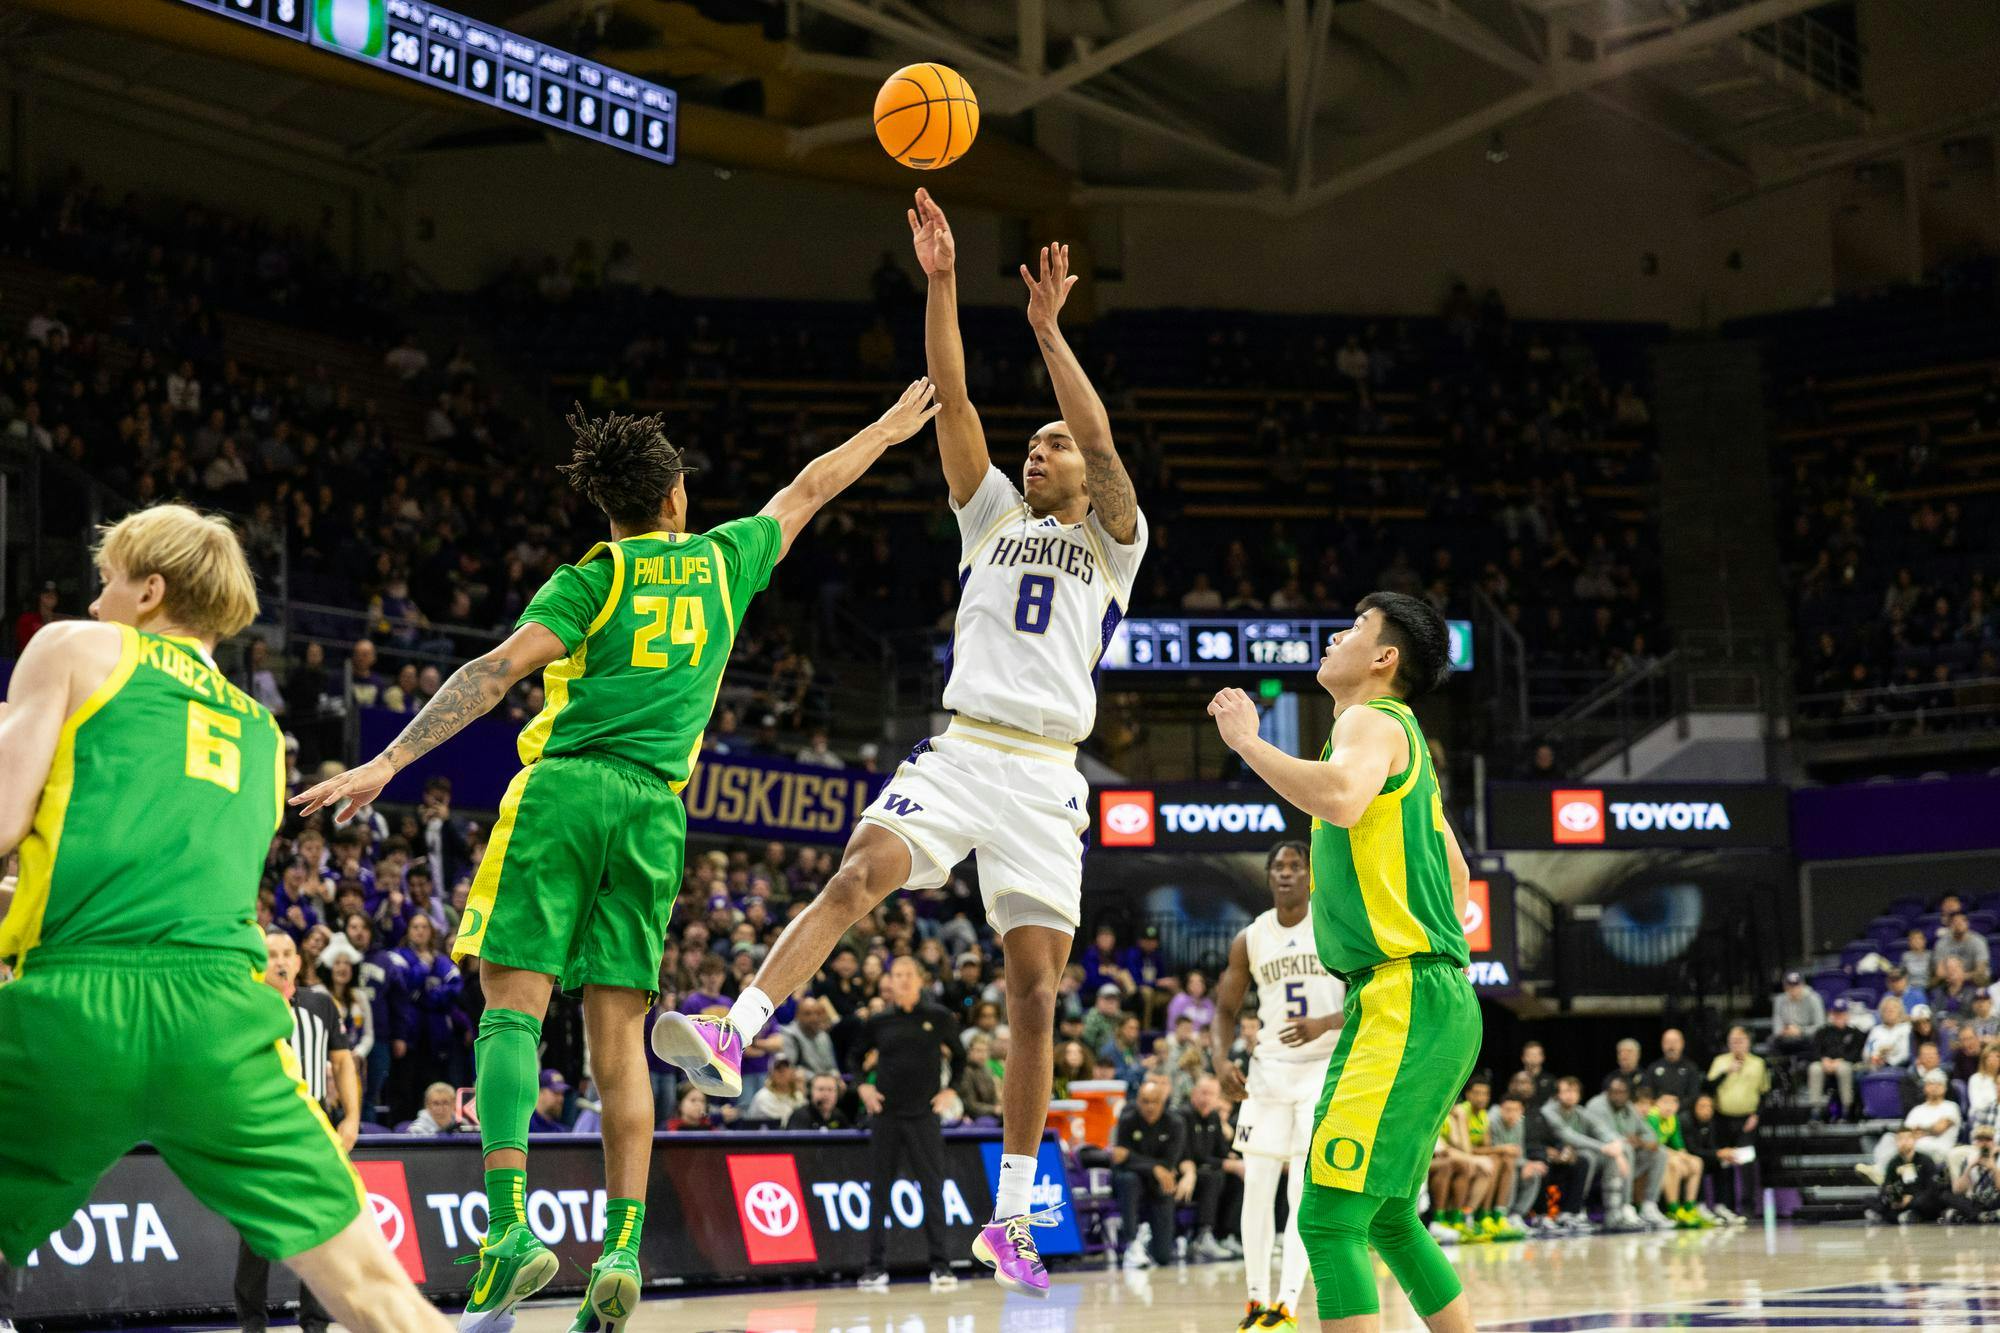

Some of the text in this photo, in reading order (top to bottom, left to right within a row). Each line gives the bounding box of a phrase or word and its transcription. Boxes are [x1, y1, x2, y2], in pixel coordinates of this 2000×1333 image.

[430, 43, 456, 79] 71
[472, 59, 489, 89] 9
[504, 70, 531, 103] 15
[546, 84, 563, 114] 3
[579, 96, 596, 126] 8
[613, 108, 630, 137] 0
[648, 119, 664, 148] 5
[633, 556, 712, 586] PHILLIPS
[1012, 571, 1058, 637] 8
[631, 595, 709, 668] 24
[1134, 638, 1153, 664] 3
[1166, 638, 1181, 664] 1
[139, 635, 276, 729] KOBZYST
[185, 699, 241, 794] 6
[882, 792, 925, 817] W
[1159, 803, 1287, 834] TOYOTA
[1608, 801, 1731, 832] TOYOTA
[1285, 981, 1309, 1019] 5
[1323, 1136, 1366, 1172] O
[425, 1189, 609, 1249] TOOT
[811, 1178, 974, 1232] TOOA
[26, 1202, 180, 1267] OTA
